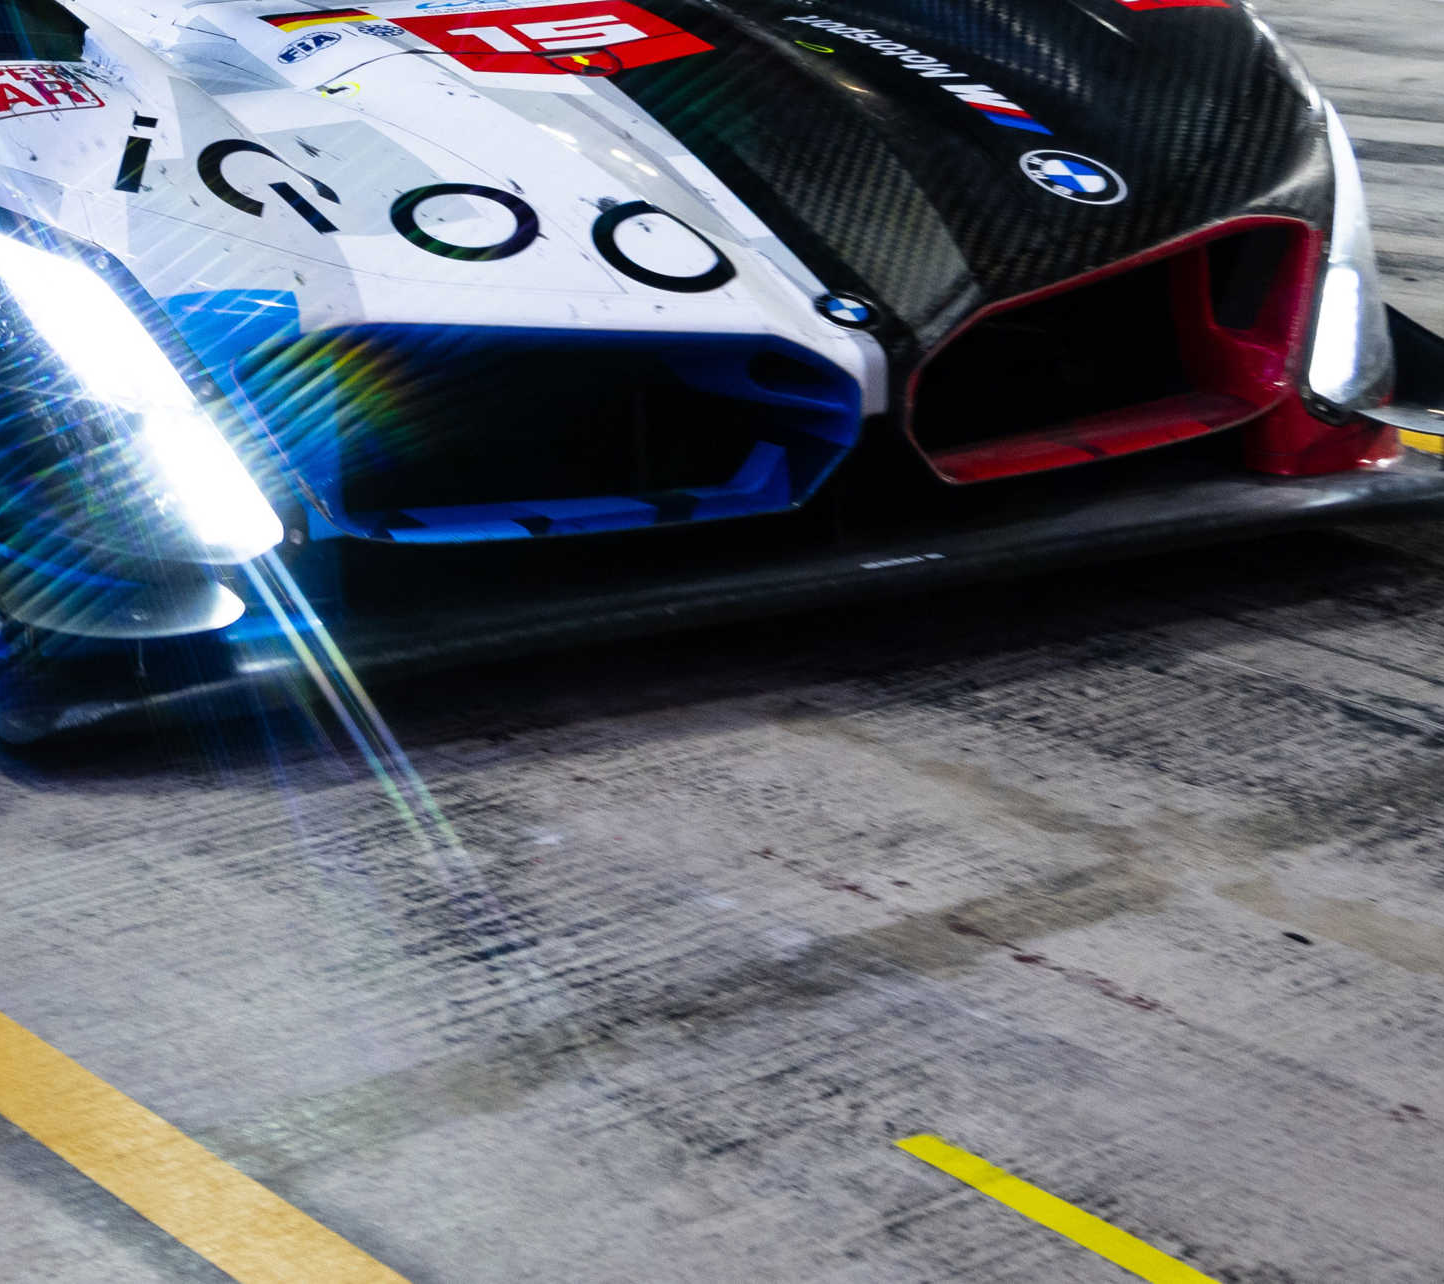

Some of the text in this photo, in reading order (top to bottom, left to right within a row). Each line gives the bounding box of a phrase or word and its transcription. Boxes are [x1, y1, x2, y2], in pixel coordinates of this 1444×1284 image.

[279, 32, 340, 63] FIA
[447, 14, 650, 53] 15
[782, 14, 970, 79] Motorsport
